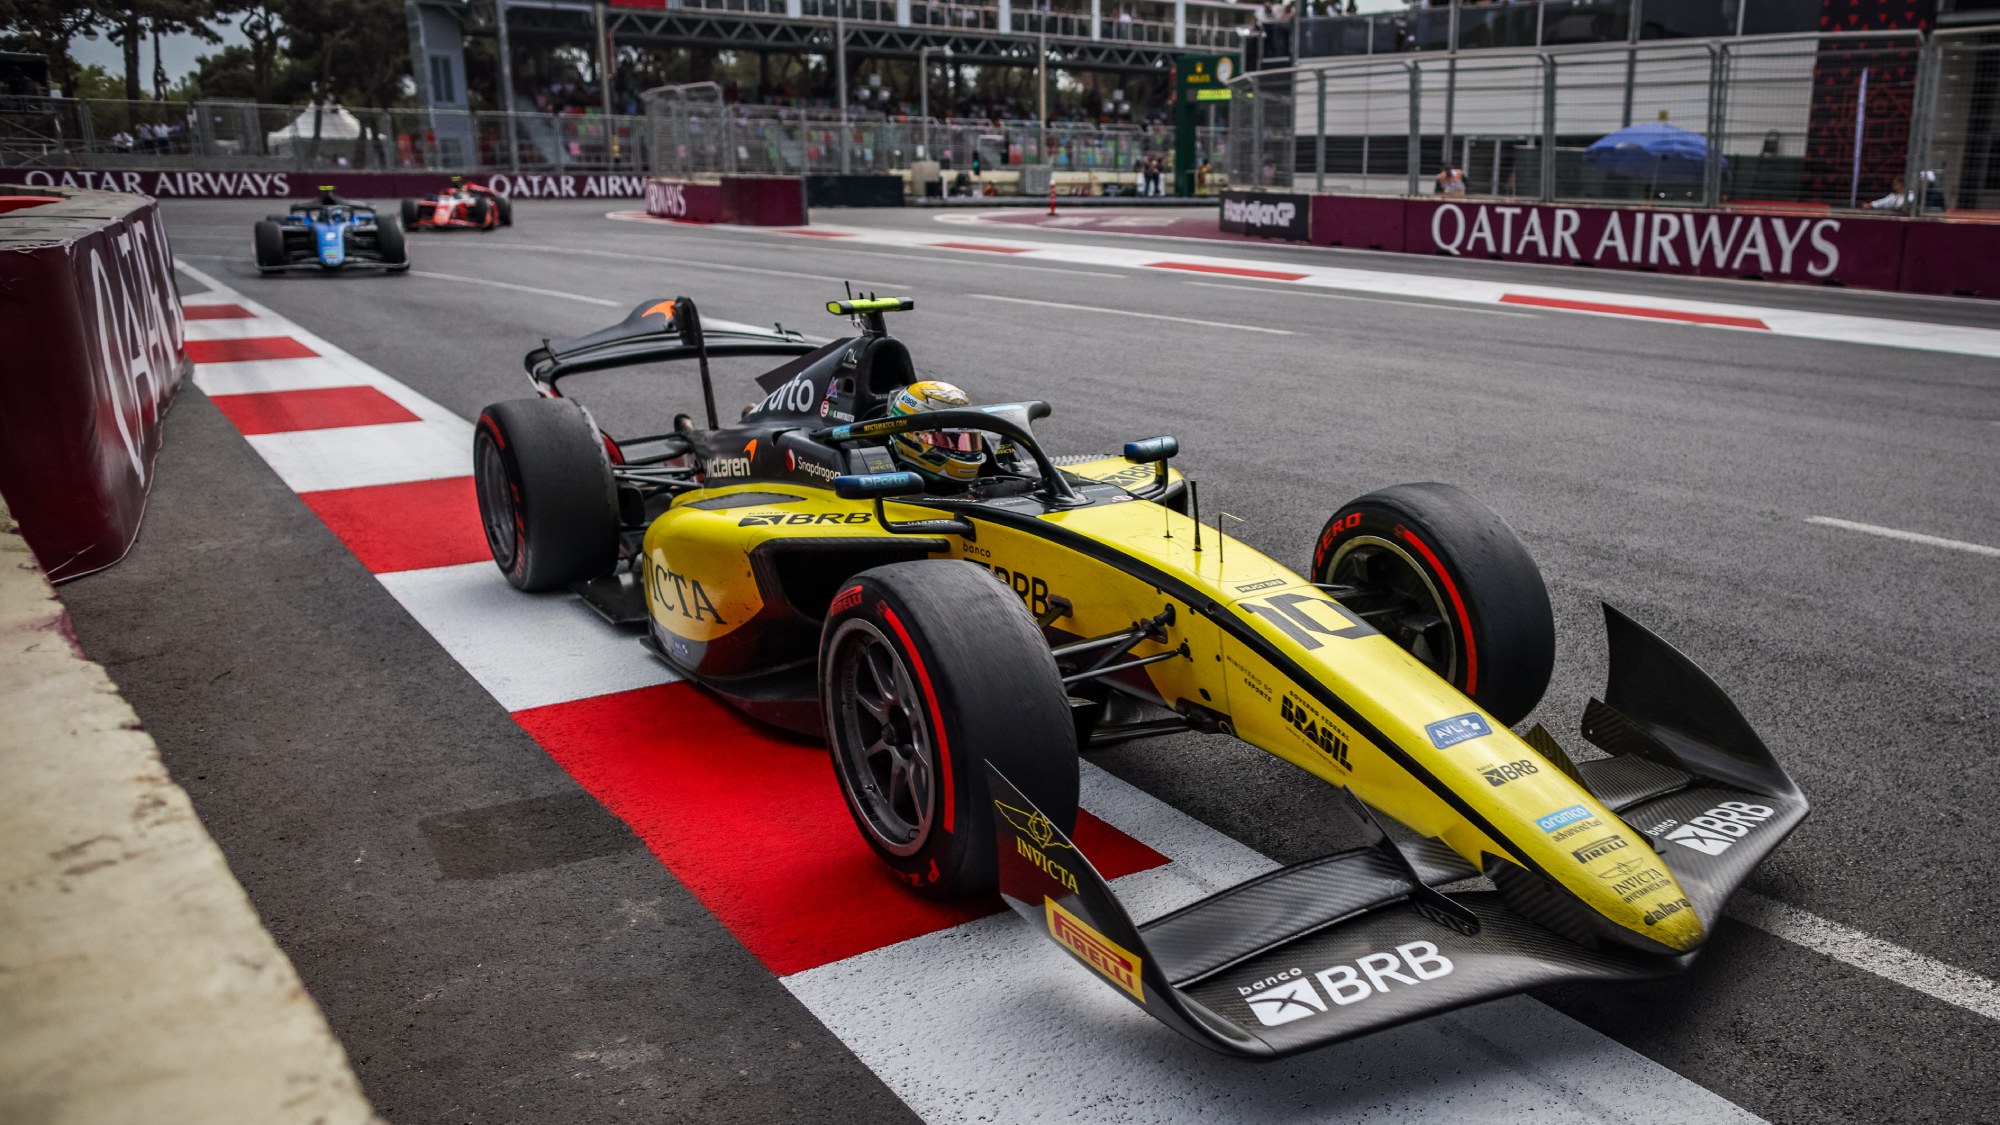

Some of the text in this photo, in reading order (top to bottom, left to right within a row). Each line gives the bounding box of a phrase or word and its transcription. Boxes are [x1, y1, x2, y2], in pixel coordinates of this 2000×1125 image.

[155, 172, 290, 196] AIRWAYS
[488, 174, 577, 200] QATAR
[1431, 203, 1841, 277] QATAR AIRWAYS
[706, 457, 750, 478] McLaren
[798, 456, 841, 482] Snapdragon
[785, 512, 873, 526] BRB
[963, 541, 991, 558] banco
[830, 585, 863, 617] PIRELLI
[1238, 593, 1383, 650] 10
[1290, 690, 1350, 741] GOVERNO FEDERAL
[1281, 695, 1353, 772] BRASIL
[1436, 725, 1463, 738] AVL
[1500, 760, 1539, 780] BRB
[1541, 807, 1588, 829] aramco
[1645, 819, 1678, 836] banco
[1689, 802, 1774, 837] BRB
[1552, 824, 1586, 842] advanced
[1571, 835, 1629, 864] PIRELLI
[1016, 836, 1080, 895] INVICTA
[1612, 868, 1663, 895] INVICTA
[1643, 898, 1692, 925] dallara
[1053, 909, 1134, 990] PIRELLI
[1237, 967, 1302, 996] banco
[1315, 940, 1454, 1006] BRB
